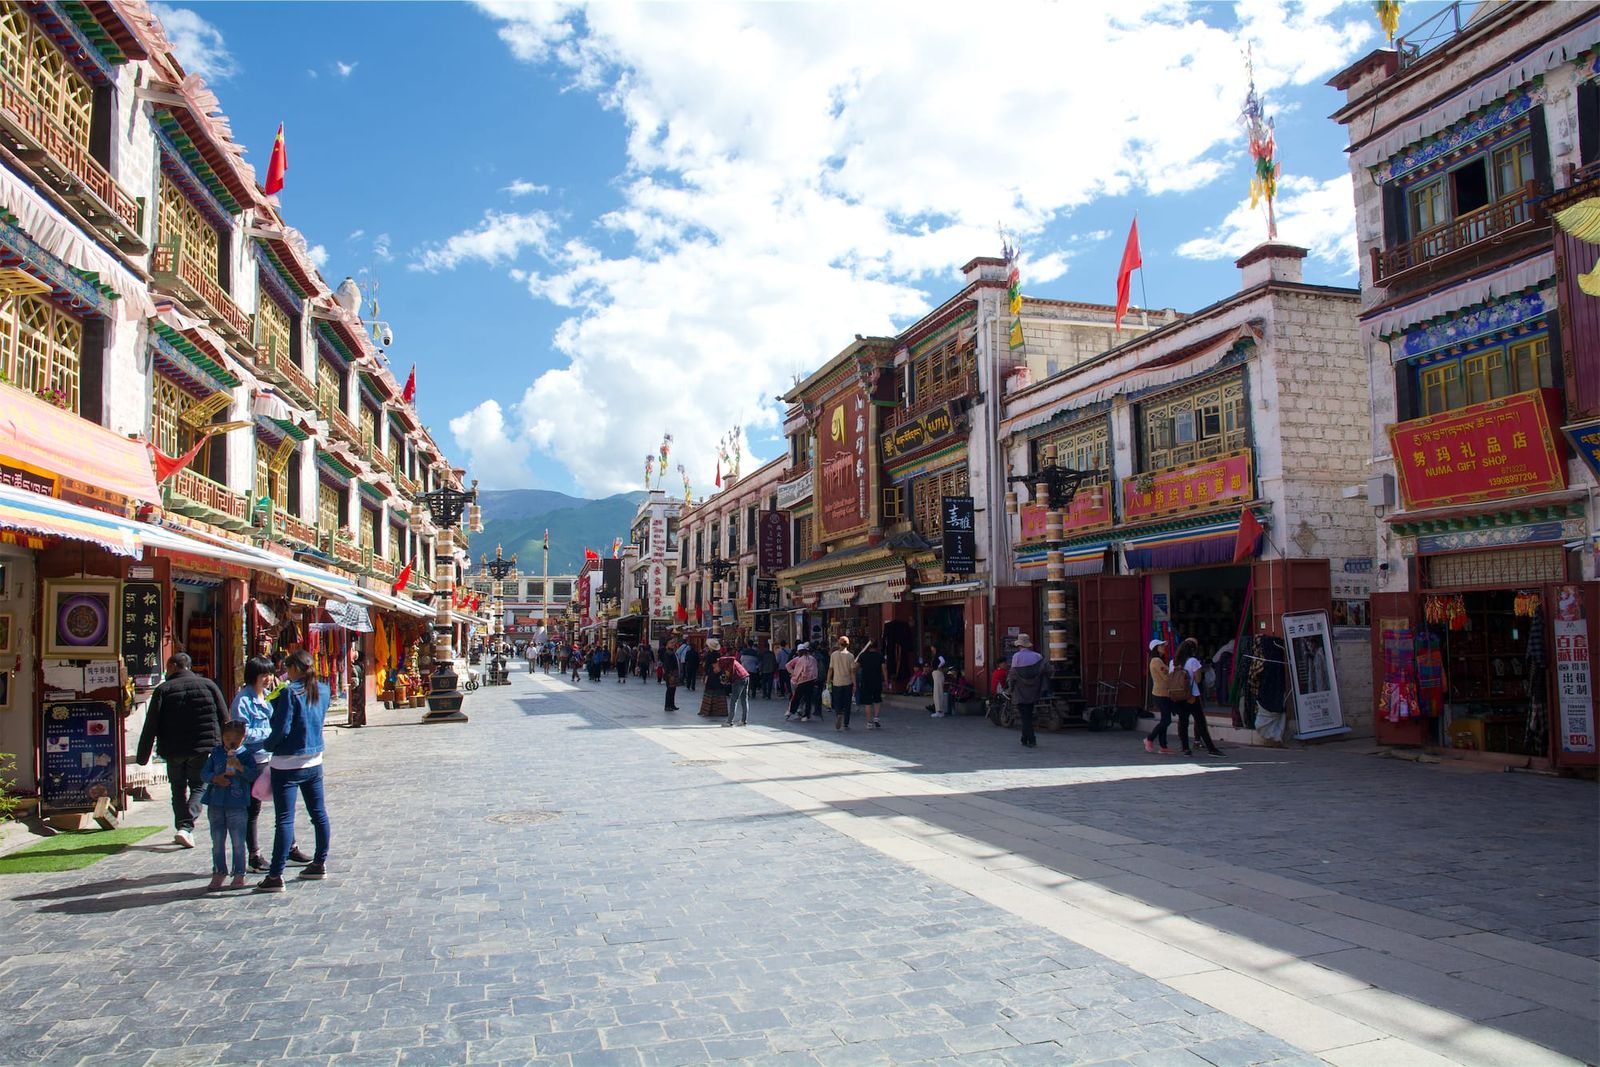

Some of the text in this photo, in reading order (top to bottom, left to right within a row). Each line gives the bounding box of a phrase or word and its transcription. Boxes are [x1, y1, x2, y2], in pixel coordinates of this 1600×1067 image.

[1413, 431, 1528, 468] 努玛礼品店
[1425, 455, 1507, 477] NUMA GIFT SHOP
[142, 591, 157, 667] 松珠博雅
[1563, 672, 1586, 683] 出租
[1563, 684, 1588, 695] 定制
